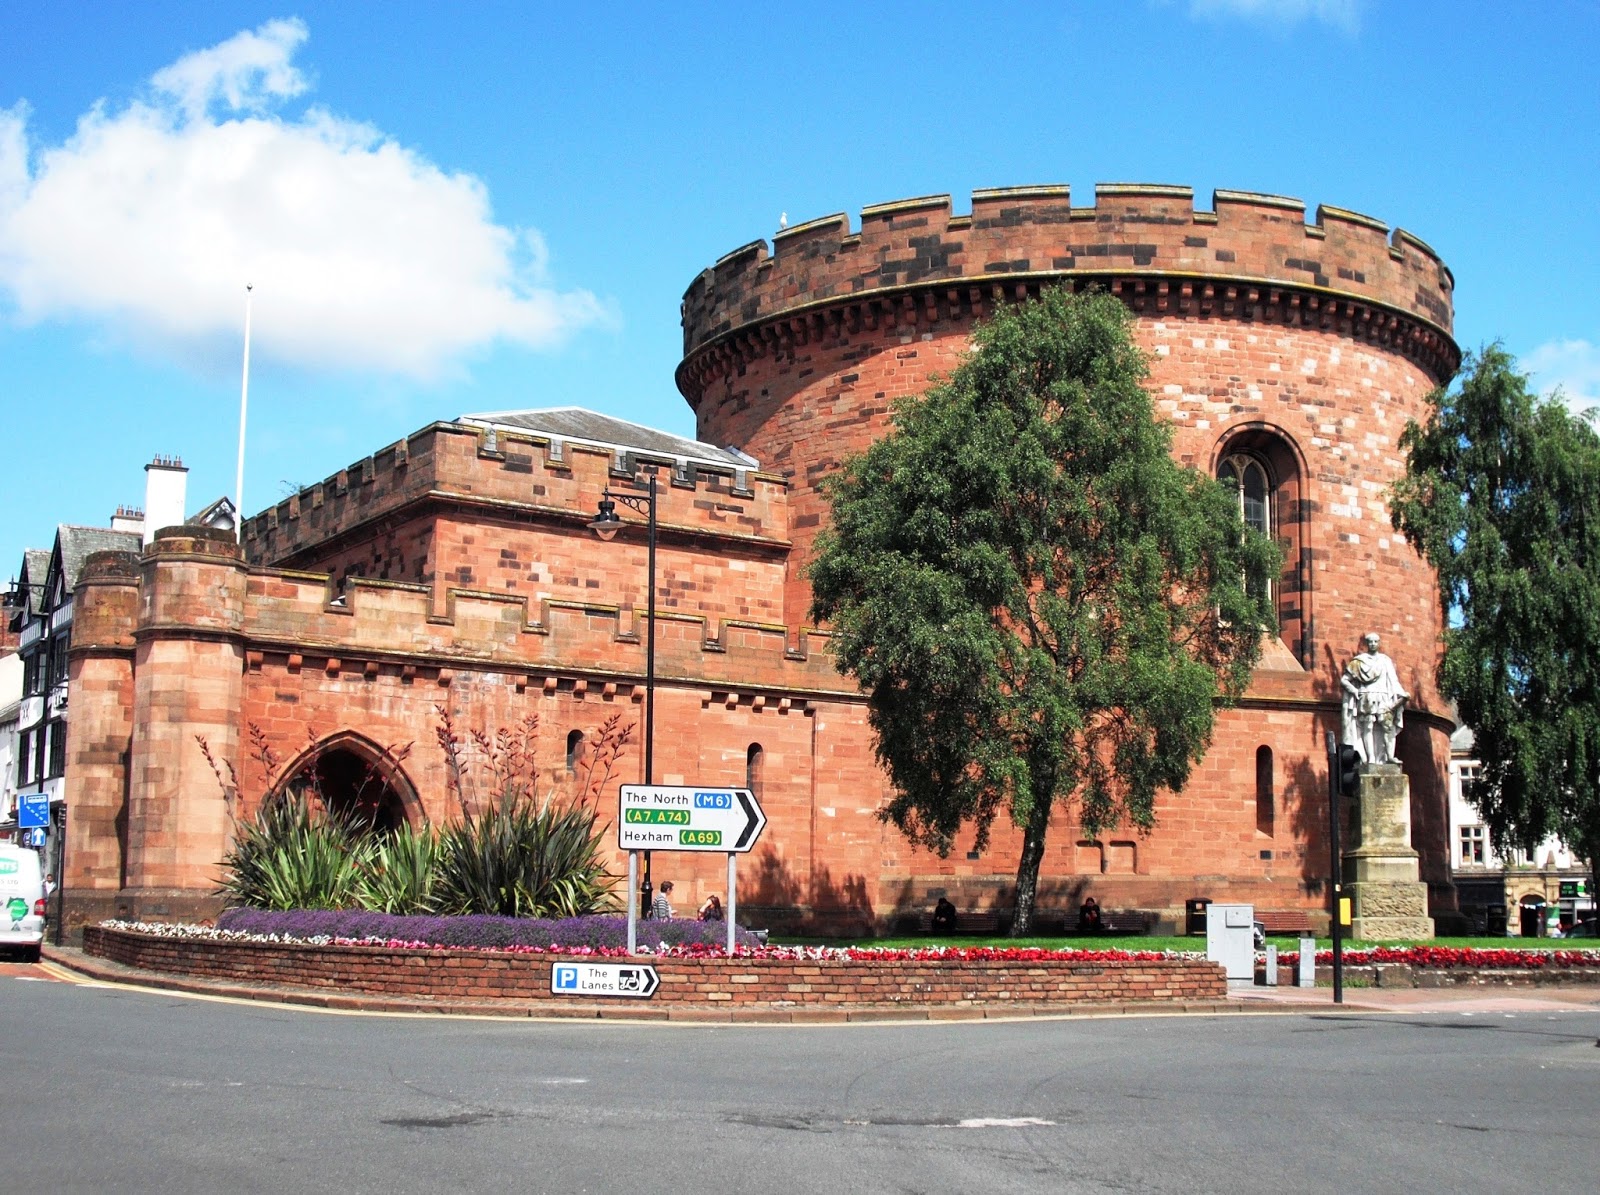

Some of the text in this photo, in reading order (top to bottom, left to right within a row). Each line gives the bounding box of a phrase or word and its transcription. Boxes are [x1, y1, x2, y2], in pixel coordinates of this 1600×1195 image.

[626, 792, 731, 808] The North (M6)
[657, 811, 690, 825] A74)
[624, 831, 721, 845] Hexham (A69)
[561, 969, 575, 988] P
[588, 968, 608, 978] The
[581, 980, 614, 990] Lanes
